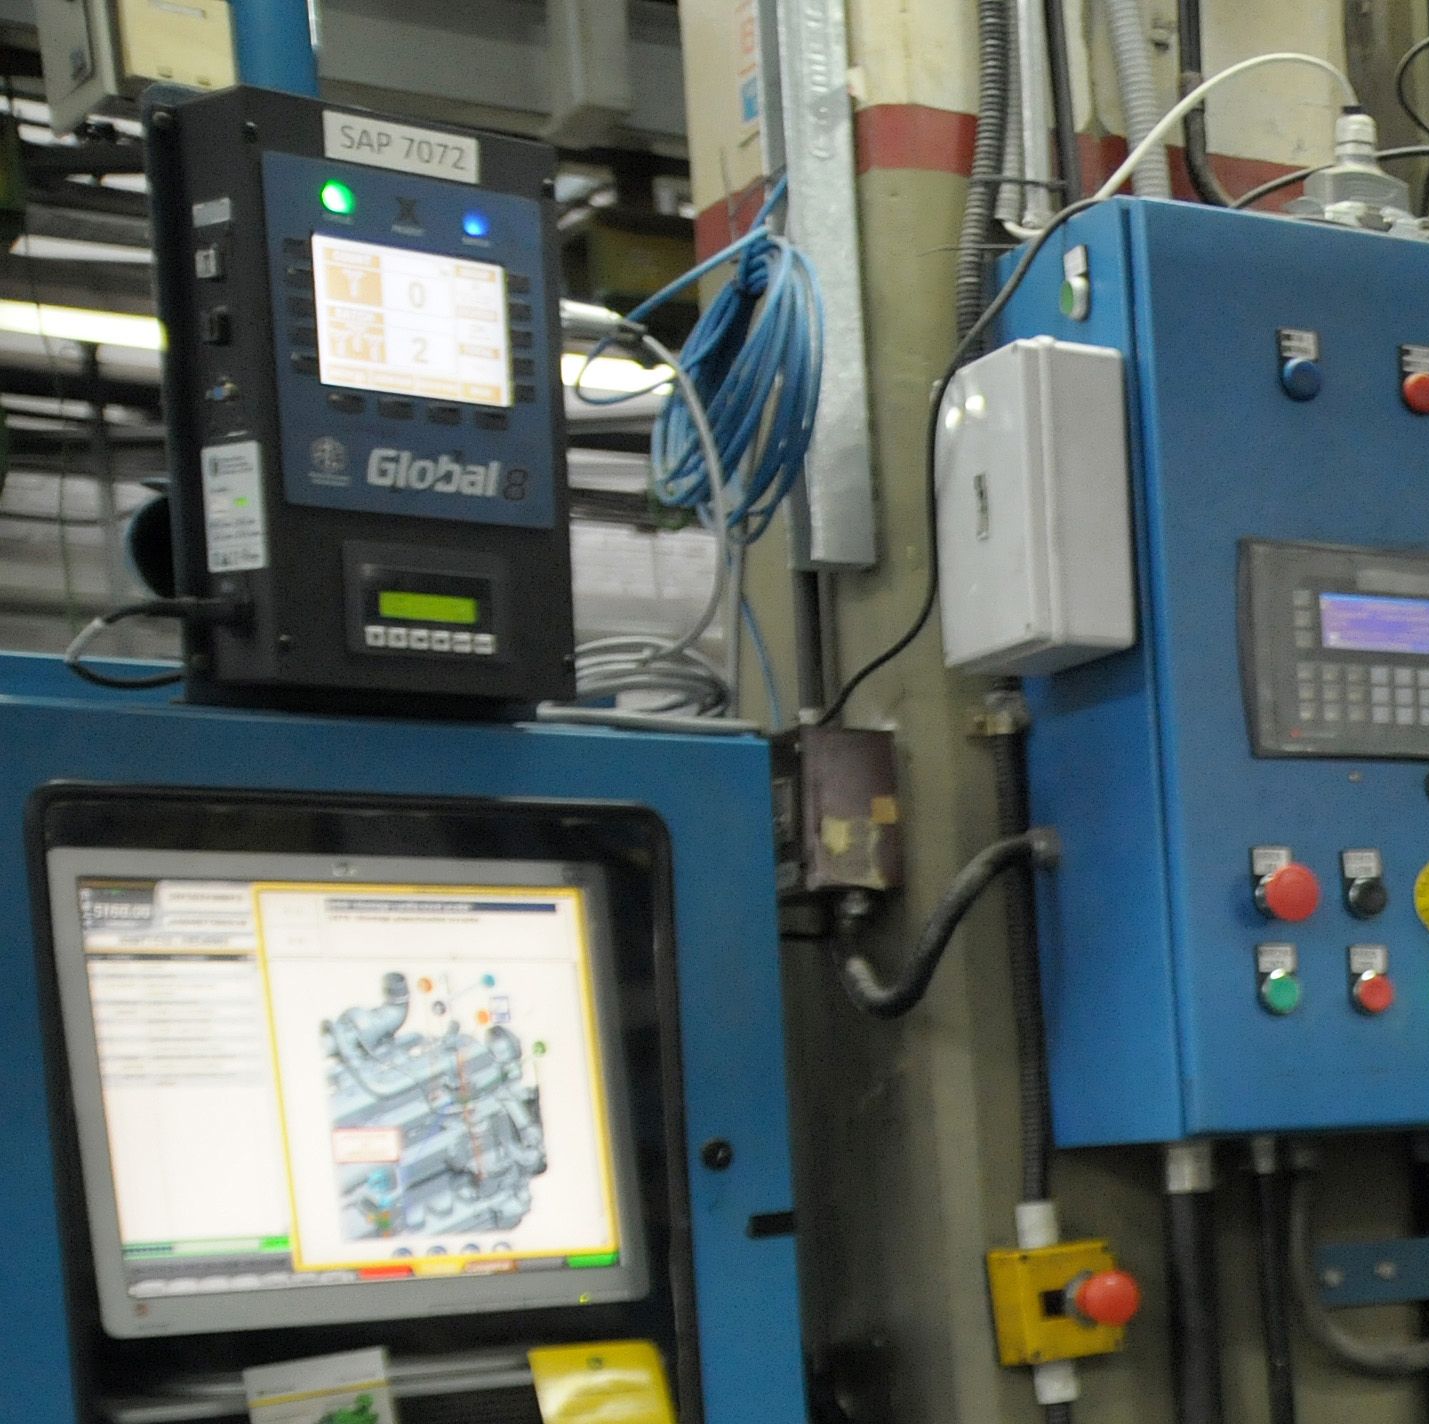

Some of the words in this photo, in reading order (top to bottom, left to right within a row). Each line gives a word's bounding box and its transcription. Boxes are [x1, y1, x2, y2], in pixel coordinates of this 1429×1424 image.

[340, 125, 392, 155] SAP
[401, 137, 468, 170] 7072
[408, 281, 426, 309] 0
[412, 337, 429, 364] 2
[366, 447, 500, 497] Global
